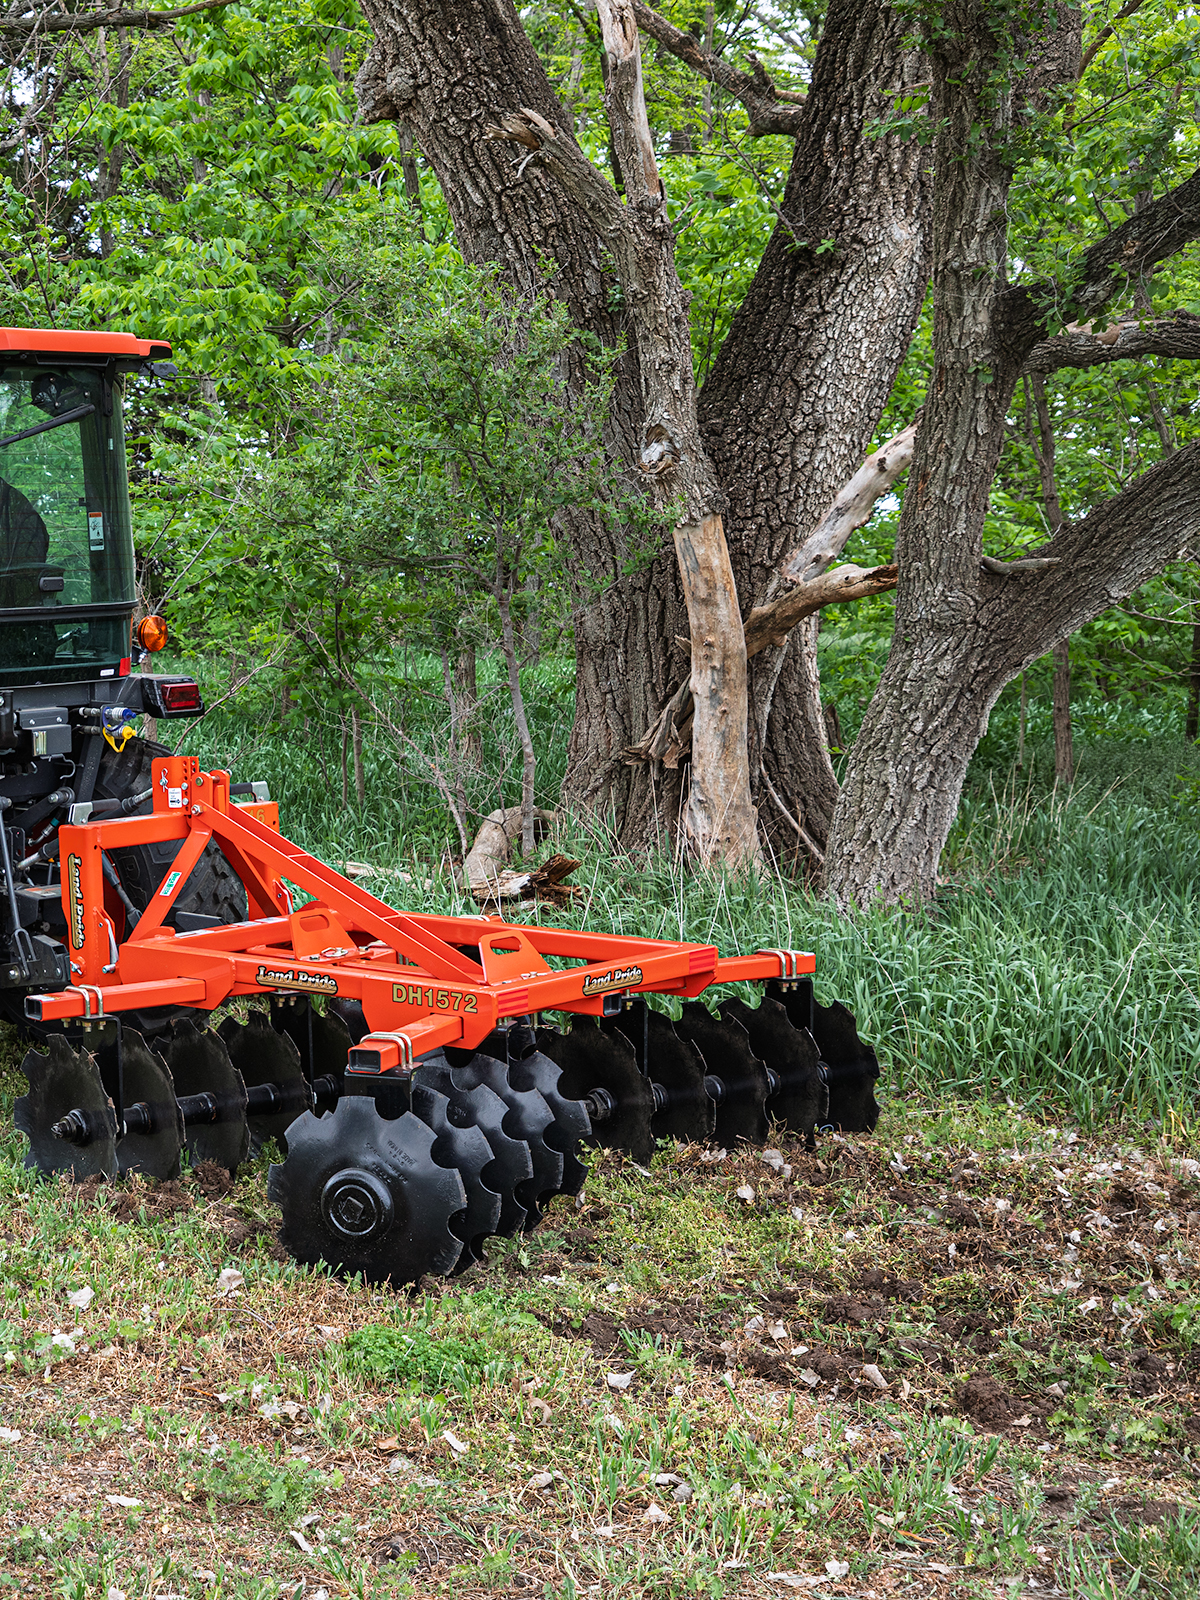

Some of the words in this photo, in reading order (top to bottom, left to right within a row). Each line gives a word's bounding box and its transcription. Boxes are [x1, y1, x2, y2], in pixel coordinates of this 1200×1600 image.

[72, 856, 83, 900] Land
[74, 902, 85, 948] Pride
[257, 966, 294, 984] Land
[297, 970, 337, 990] Pride
[584, 971, 612, 990] Land
[614, 965, 643, 982] Pride
[392, 983, 478, 1014] DH1572
